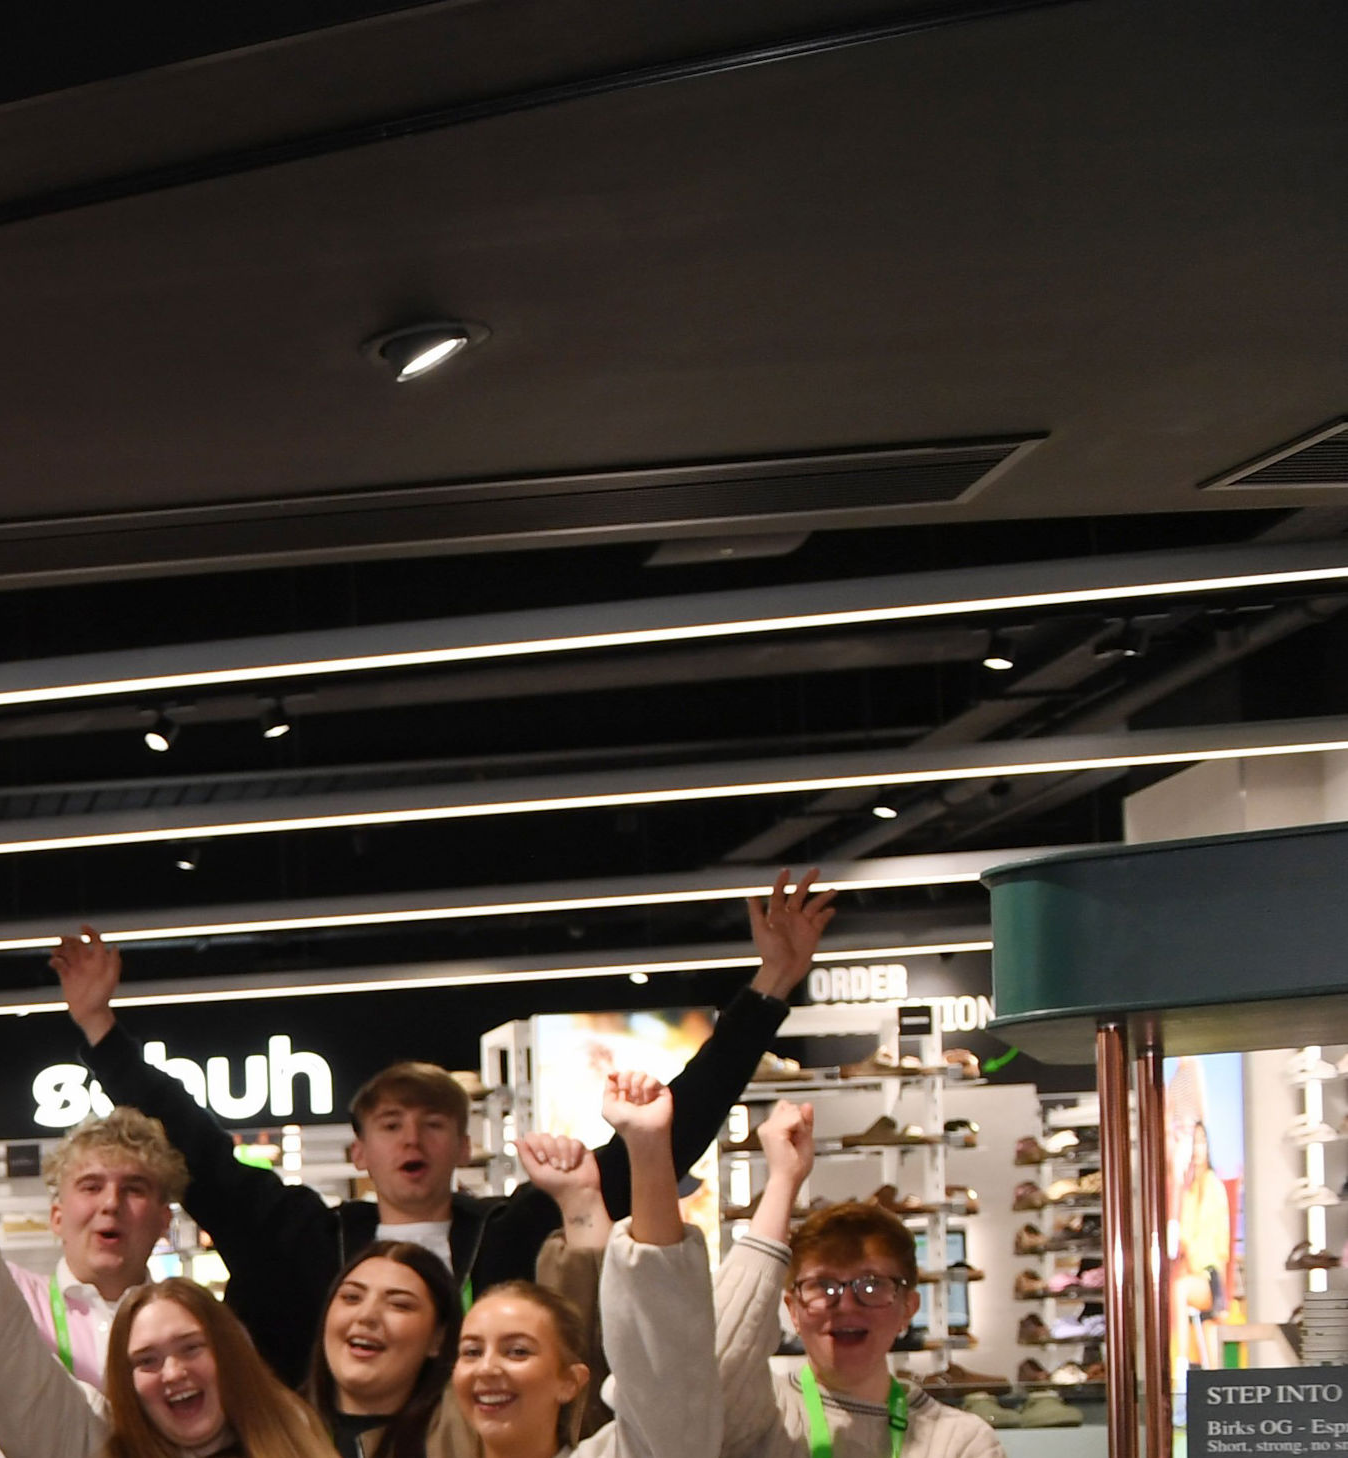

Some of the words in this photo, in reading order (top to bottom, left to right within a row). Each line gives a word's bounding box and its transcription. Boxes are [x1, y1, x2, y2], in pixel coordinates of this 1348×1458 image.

[808, 964, 908, 1002] ORDER
[1207, 1385, 1271, 1404] STEP
[1276, 1384, 1343, 1403] INTO
[1207, 1420, 1255, 1436] Birks
[1260, 1420, 1293, 1435] OG
[1311, 1441, 1330, 1450] no
